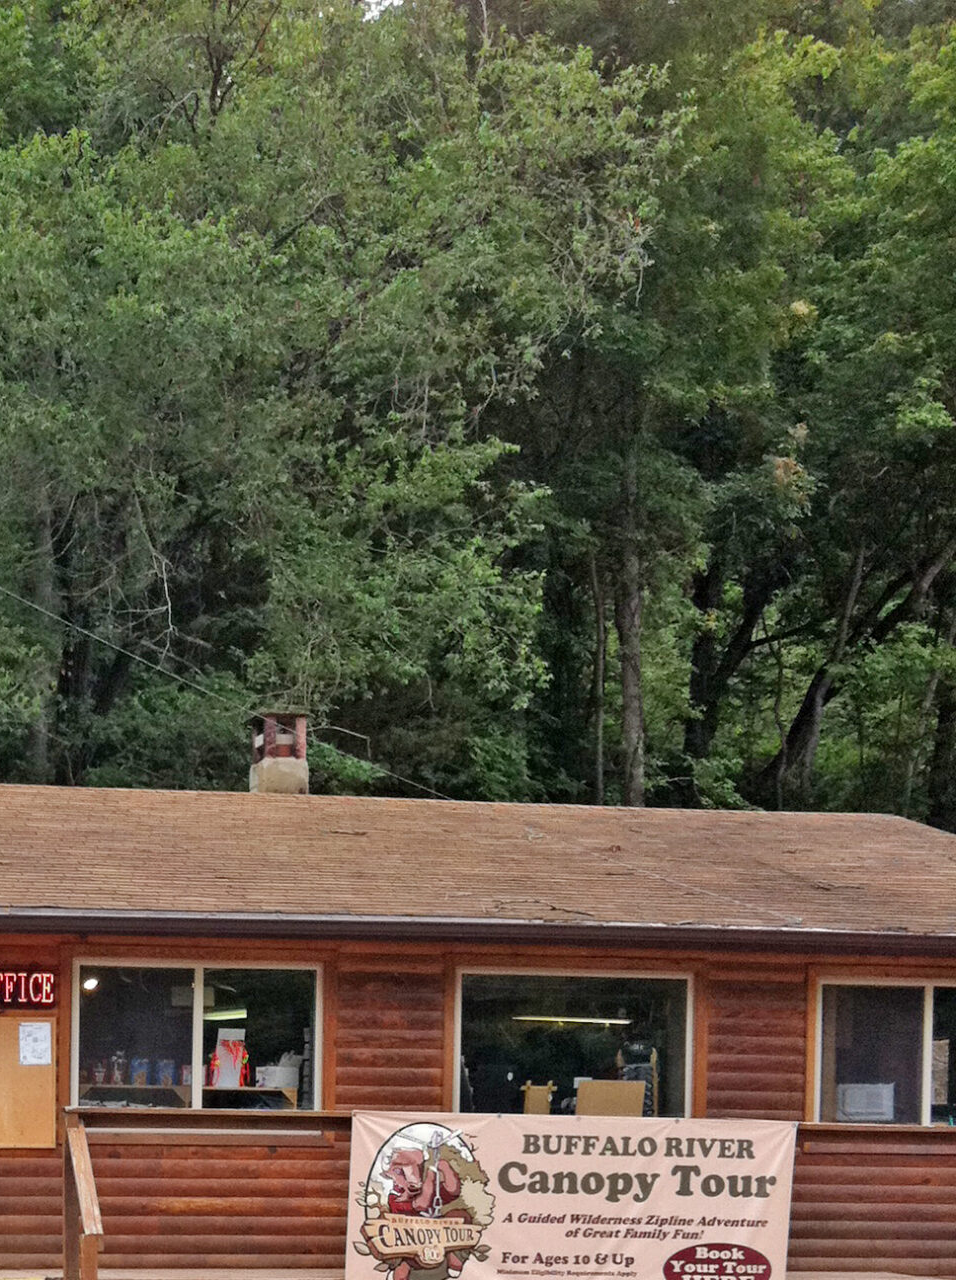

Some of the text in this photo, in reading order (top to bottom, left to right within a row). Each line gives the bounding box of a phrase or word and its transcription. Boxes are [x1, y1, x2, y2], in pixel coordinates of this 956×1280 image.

[522, 1134, 755, 1159] BUFFALO RIVER
[497, 1161, 777, 1203] Canopy Tour
[502, 1213, 768, 1228] A Guided Wilderness Zipline Adventure
[378, 1224, 474, 1248] CANOPY TOUR
[565, 1227, 704, 1241] of Great Family Fun!
[501, 1252, 635, 1268] For Ages 10 & Up
[695, 1246, 745, 1260] Book
[670, 1260, 767, 1274] Your Tour
